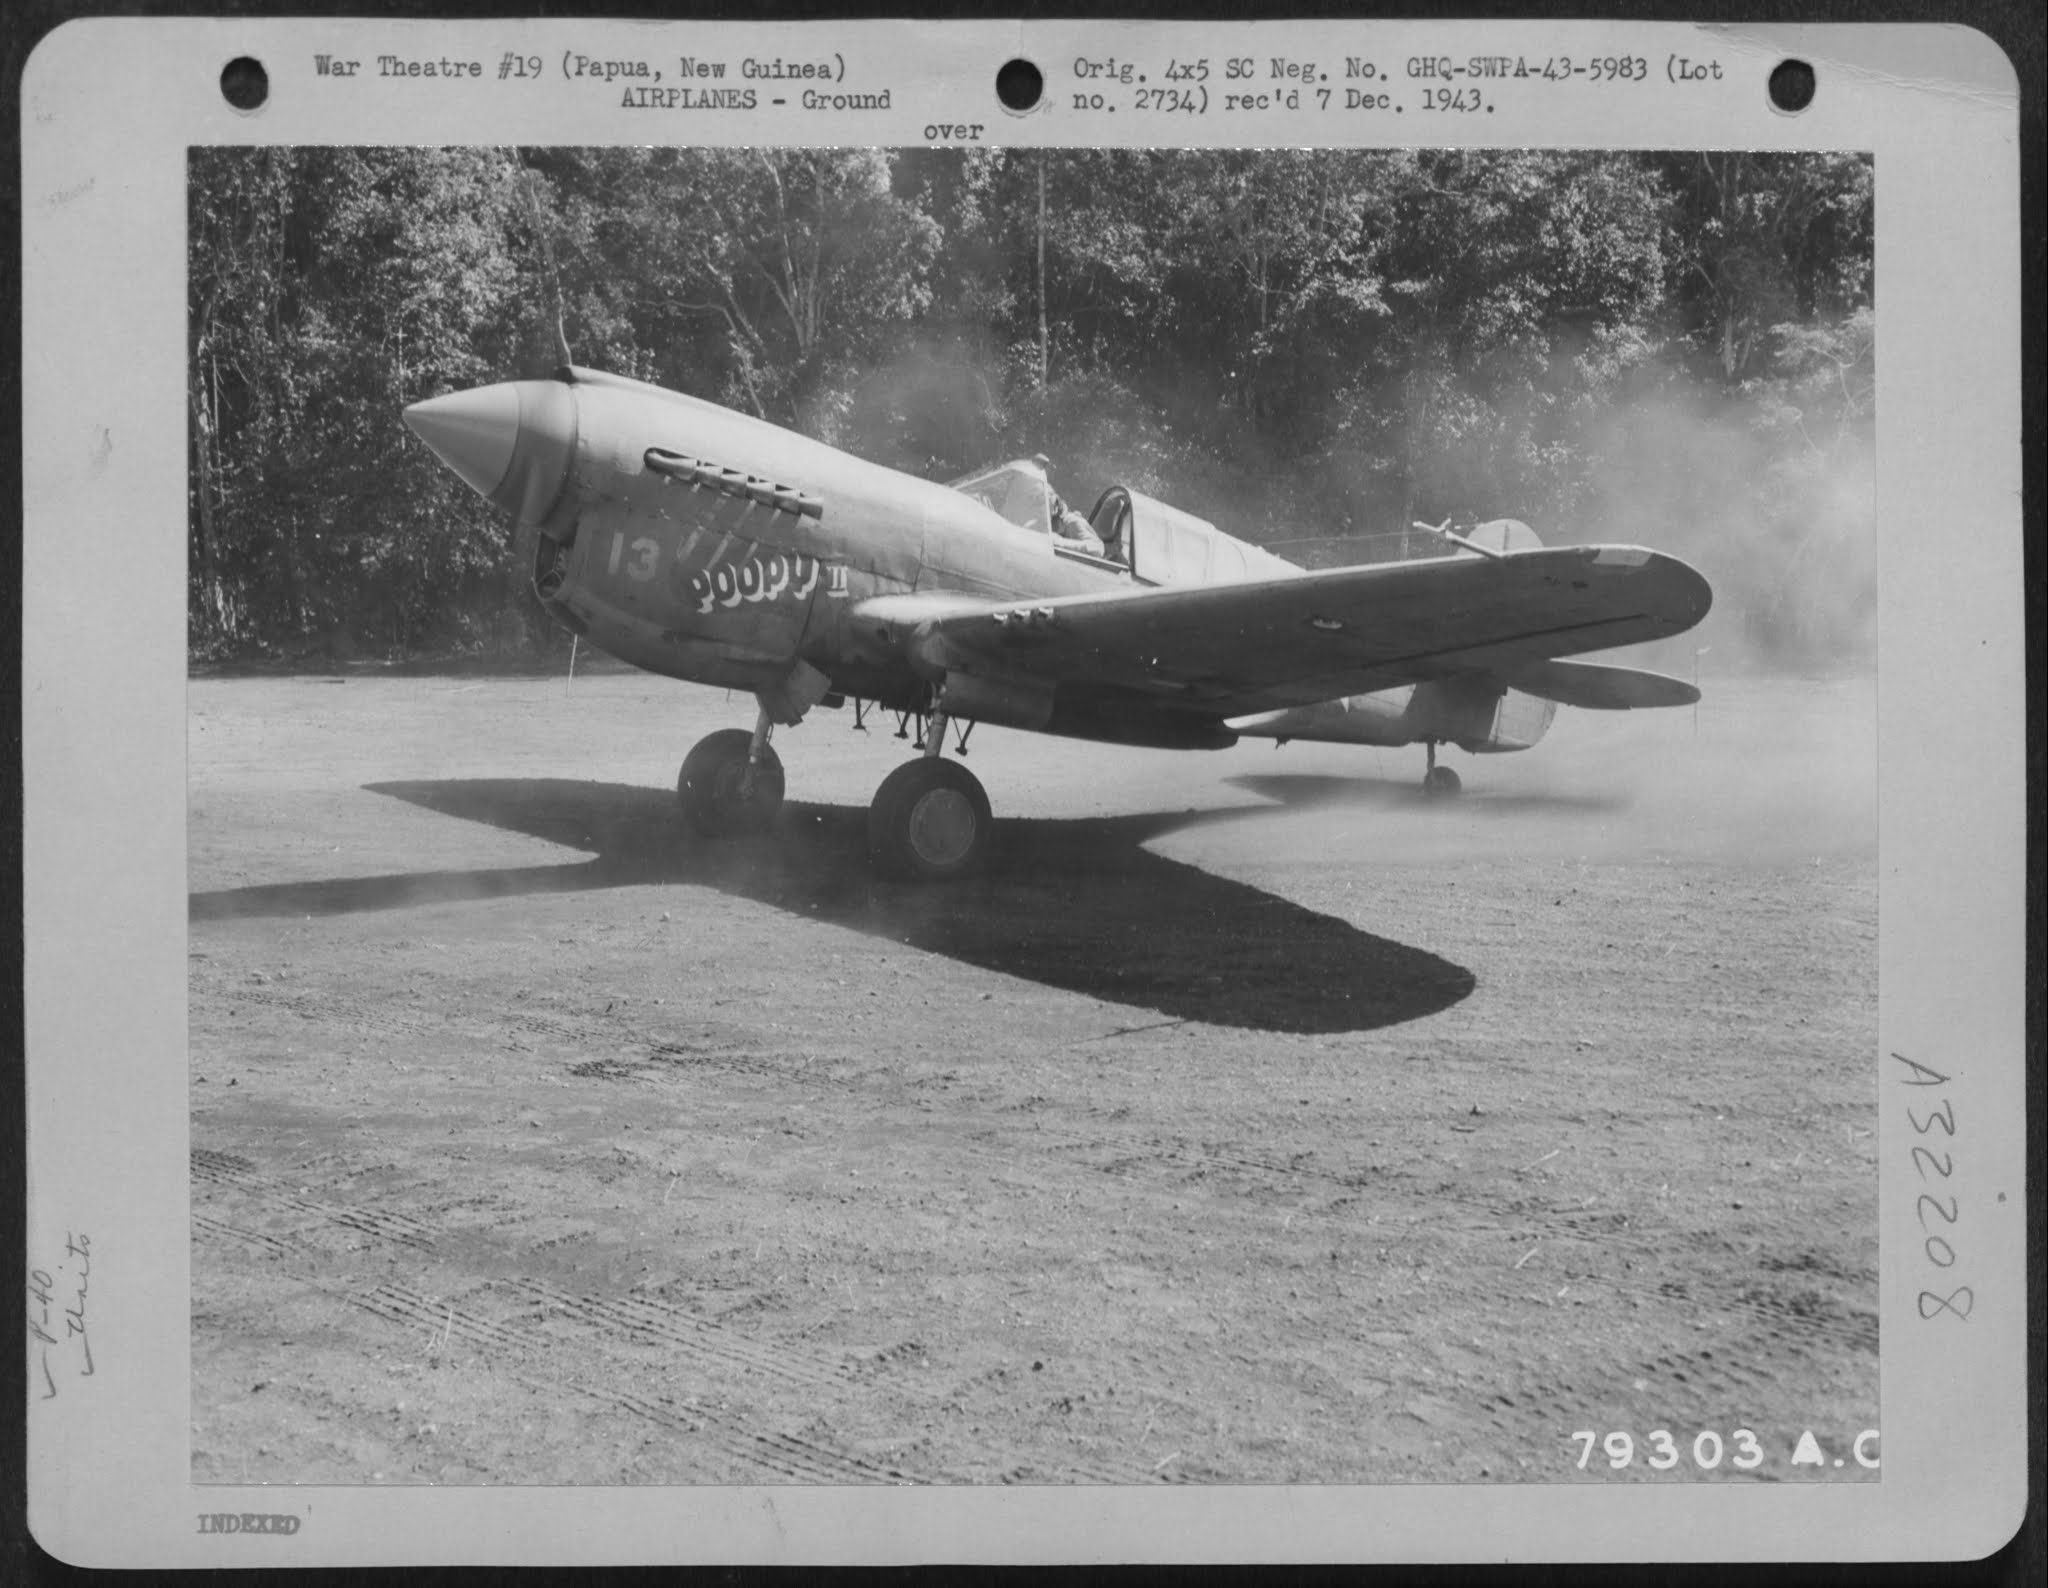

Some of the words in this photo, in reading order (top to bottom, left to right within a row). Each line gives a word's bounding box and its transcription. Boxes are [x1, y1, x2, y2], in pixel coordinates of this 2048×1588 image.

[315, 56, 361, 78] War
[378, 56, 482, 78] Theatre
[498, 54, 542, 79] #19
[562, 51, 661, 81] (Papua,
[680, 56, 725, 78] New
[742, 54, 845, 82] Guinea)
[1074, 57, 1146, 84] Orig.
[1165, 58, 1209, 82] 4x5
[1225, 58, 1254, 79] SC
[1270, 58, 1328, 83] Neg.
[1345, 58, 1388, 81] No.
[1407, 56, 1647, 81] GHQ-SWPA-43-5983
[1667, 55, 1723, 83] (Lot
[621, 88, 757, 110] AIRPLANES
[802, 89, 891, 110] Ground
[1073, 92, 1116, 113] no.
[1135, 89, 1207, 114] 2734)
[1225, 88, 1299, 110] rec'd
[1316, 88, 1331, 111] 7
[1345, 88, 1403, 113] Dec.
[1423, 89, 1494, 113] 1943.
[924, 123, 985, 140] over
[607, 532, 661, 582] 13
[825, 564, 850, 598] II
[1890, 1052, 1974, 1322] A32208
[197, 1513, 301, 1535] INDEXED
